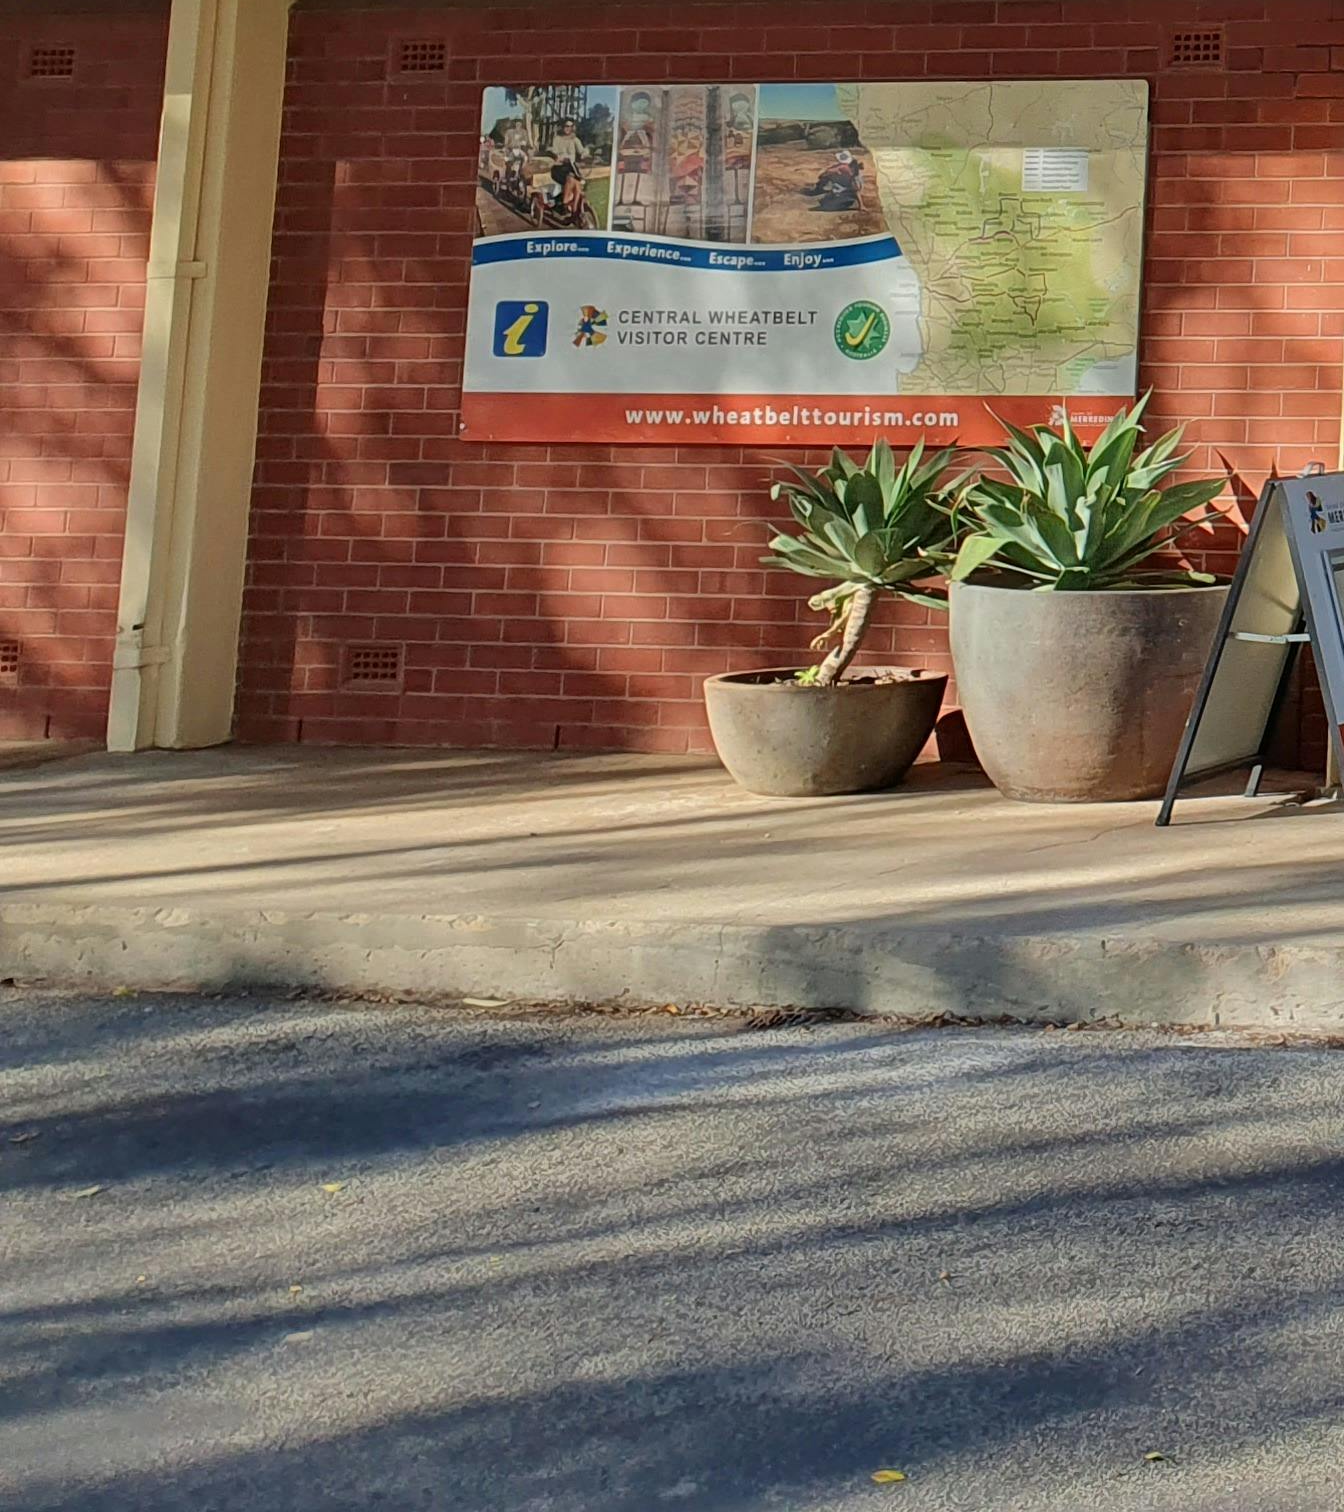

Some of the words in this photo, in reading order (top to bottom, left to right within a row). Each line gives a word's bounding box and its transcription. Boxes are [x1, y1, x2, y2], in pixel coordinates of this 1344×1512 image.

[618, 310, 703, 324] CENTRAL
[708, 310, 818, 325] WHEATBELT
[617, 331, 688, 345] VISITOR
[695, 331, 768, 346] CENTRE
[625, 405, 960, 426] www.wheatbelttourism.com
